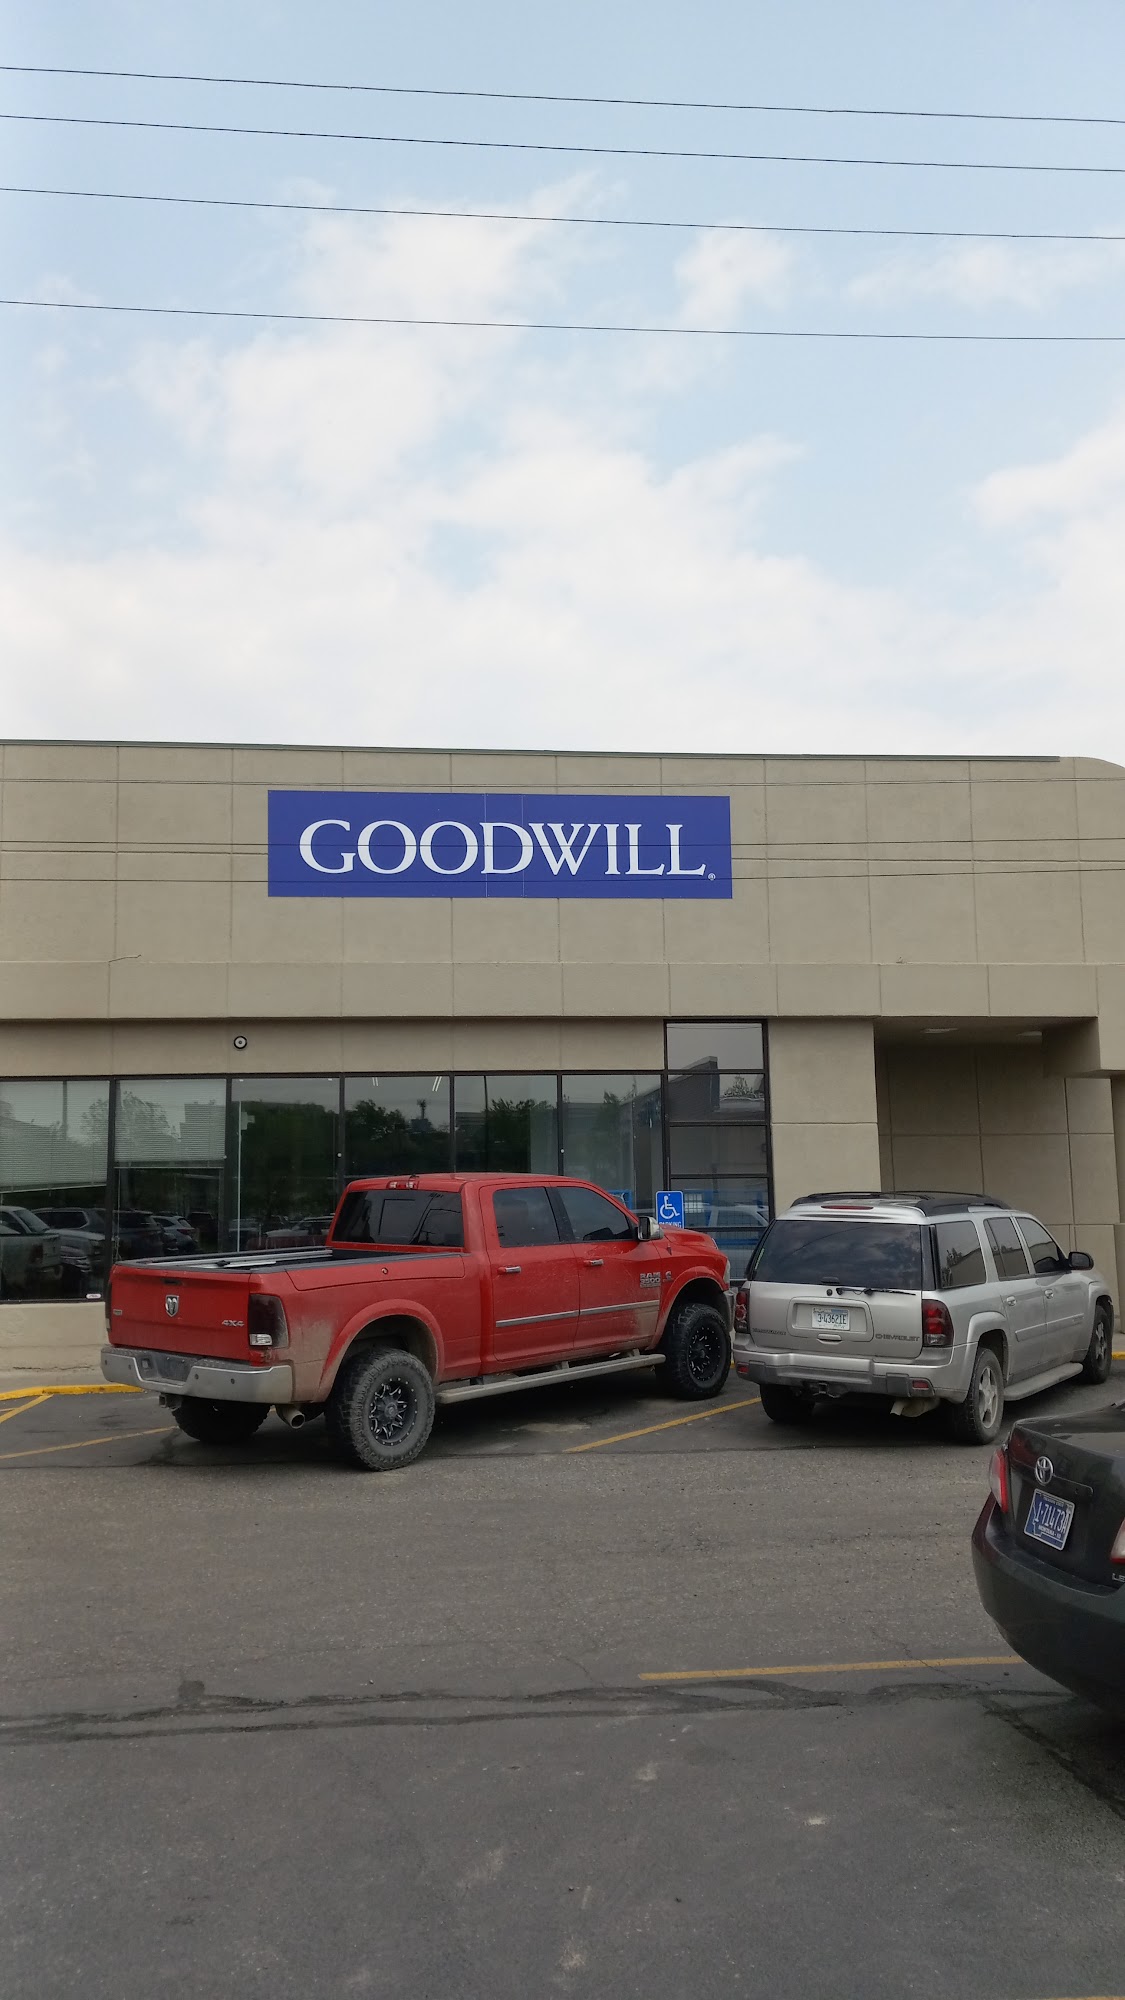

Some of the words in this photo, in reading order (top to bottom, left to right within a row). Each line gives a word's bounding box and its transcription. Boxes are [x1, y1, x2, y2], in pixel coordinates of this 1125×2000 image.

[299, 819, 707, 876] GOODWILL
[640, 1271, 661, 1279] RAM
[875, 1333, 920, 1342] CHEVROLET
